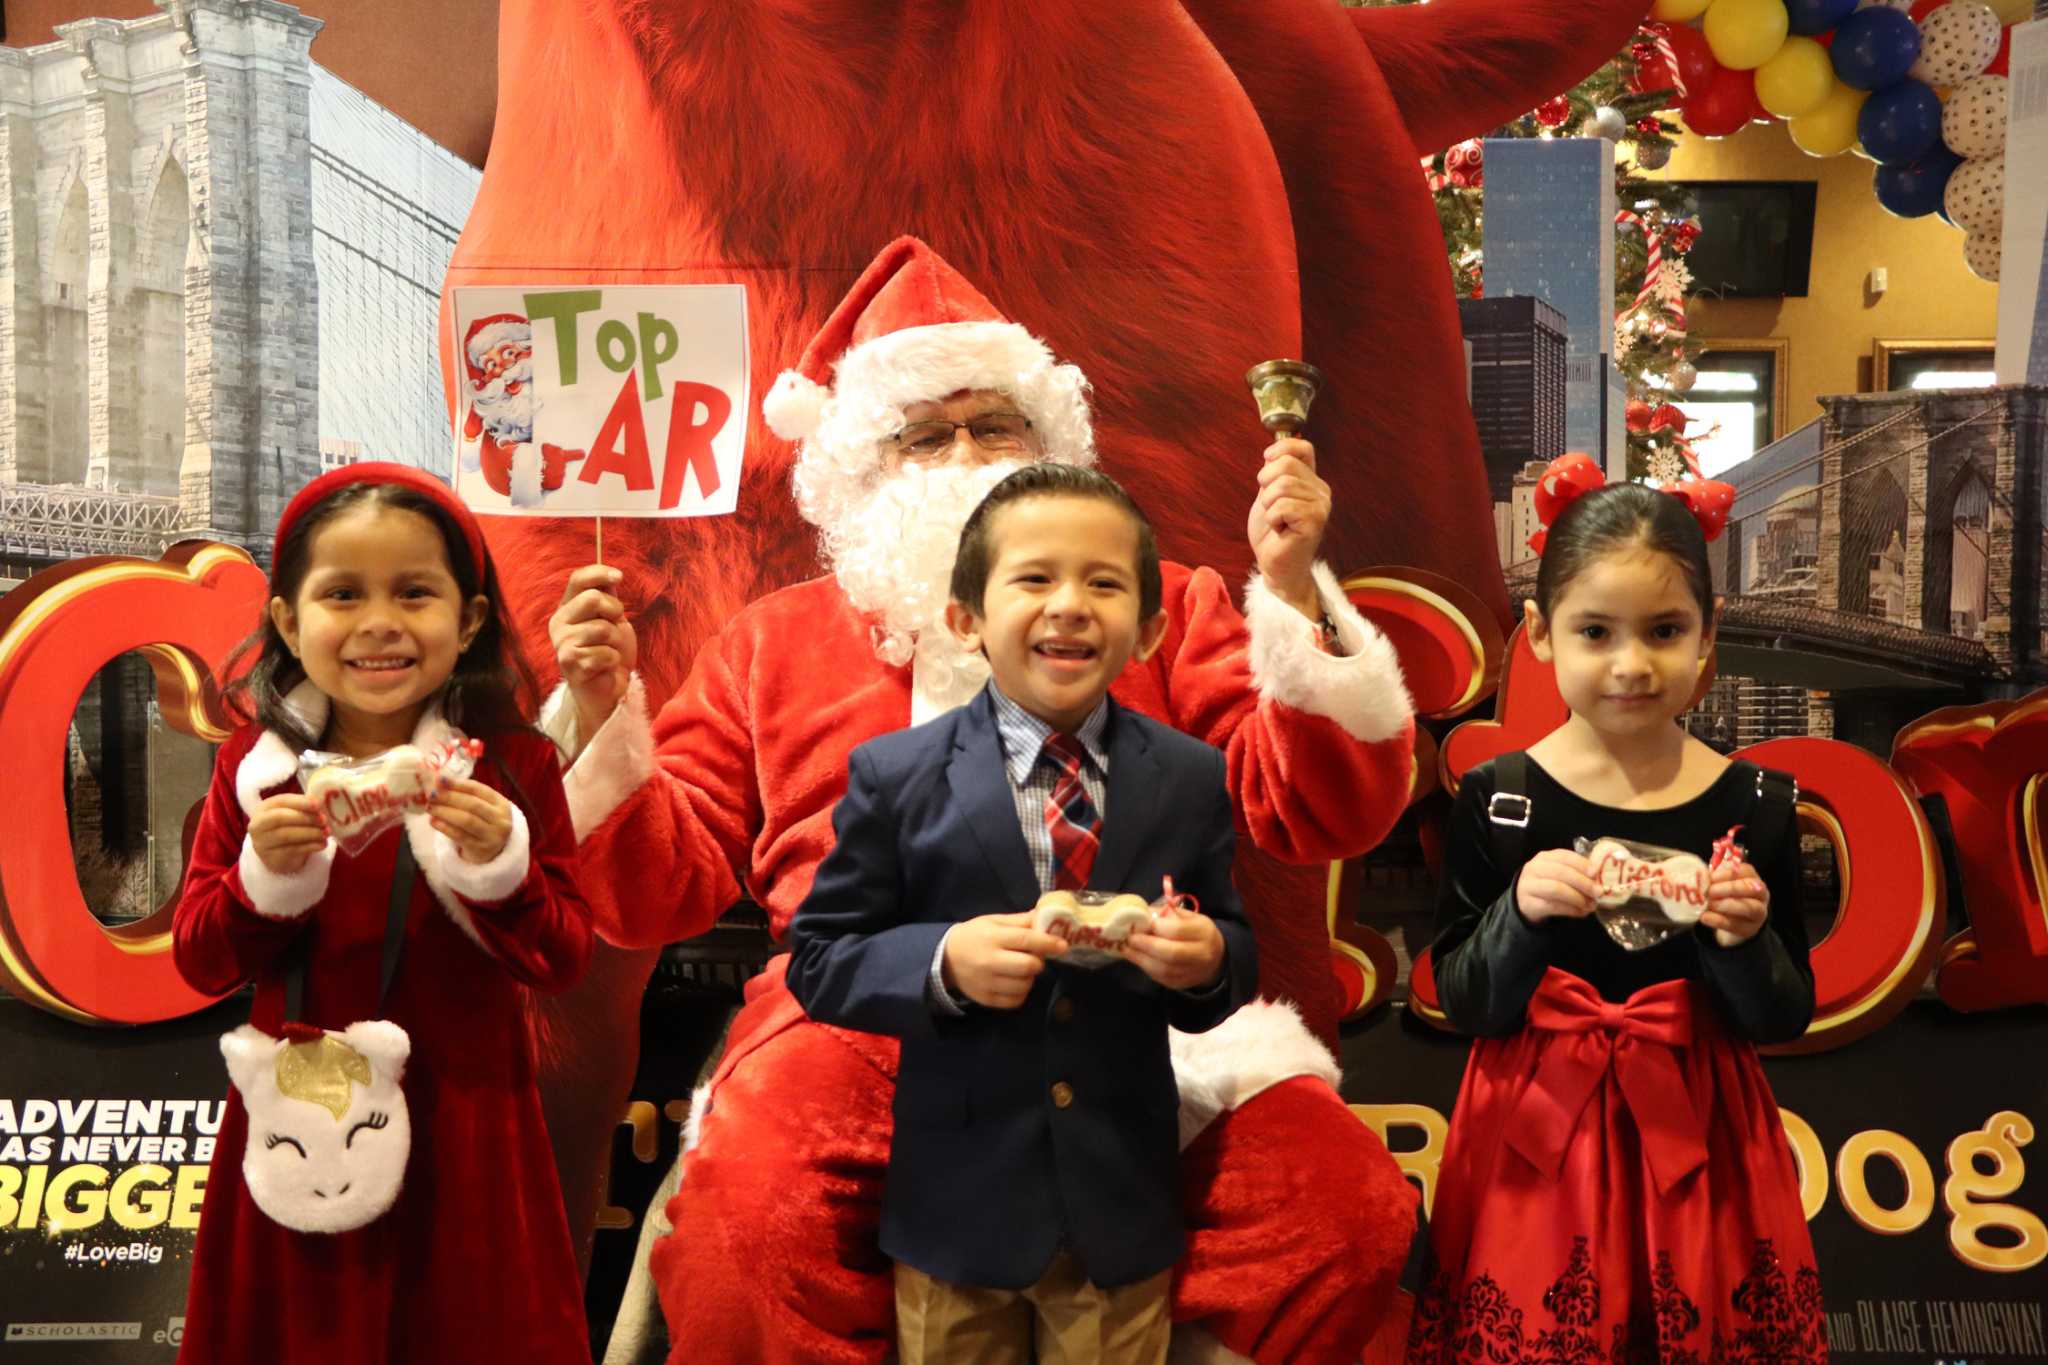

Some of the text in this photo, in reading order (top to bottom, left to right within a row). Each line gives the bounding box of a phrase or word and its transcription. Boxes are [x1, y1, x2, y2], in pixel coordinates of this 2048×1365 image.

[577, 368, 732, 510] AR
[0, 1100, 228, 1134] ADVENTU
[0, 1136, 55, 1161] AS
[61, 1136, 188, 1162] NEVER
[64, 1243, 163, 1263] #LoveBig
[26, 1326, 138, 1337] SCHOLASTIC
[1857, 1300, 1926, 1353] BLAISE
[1926, 1301, 2047, 1356] HEMINGWAY
